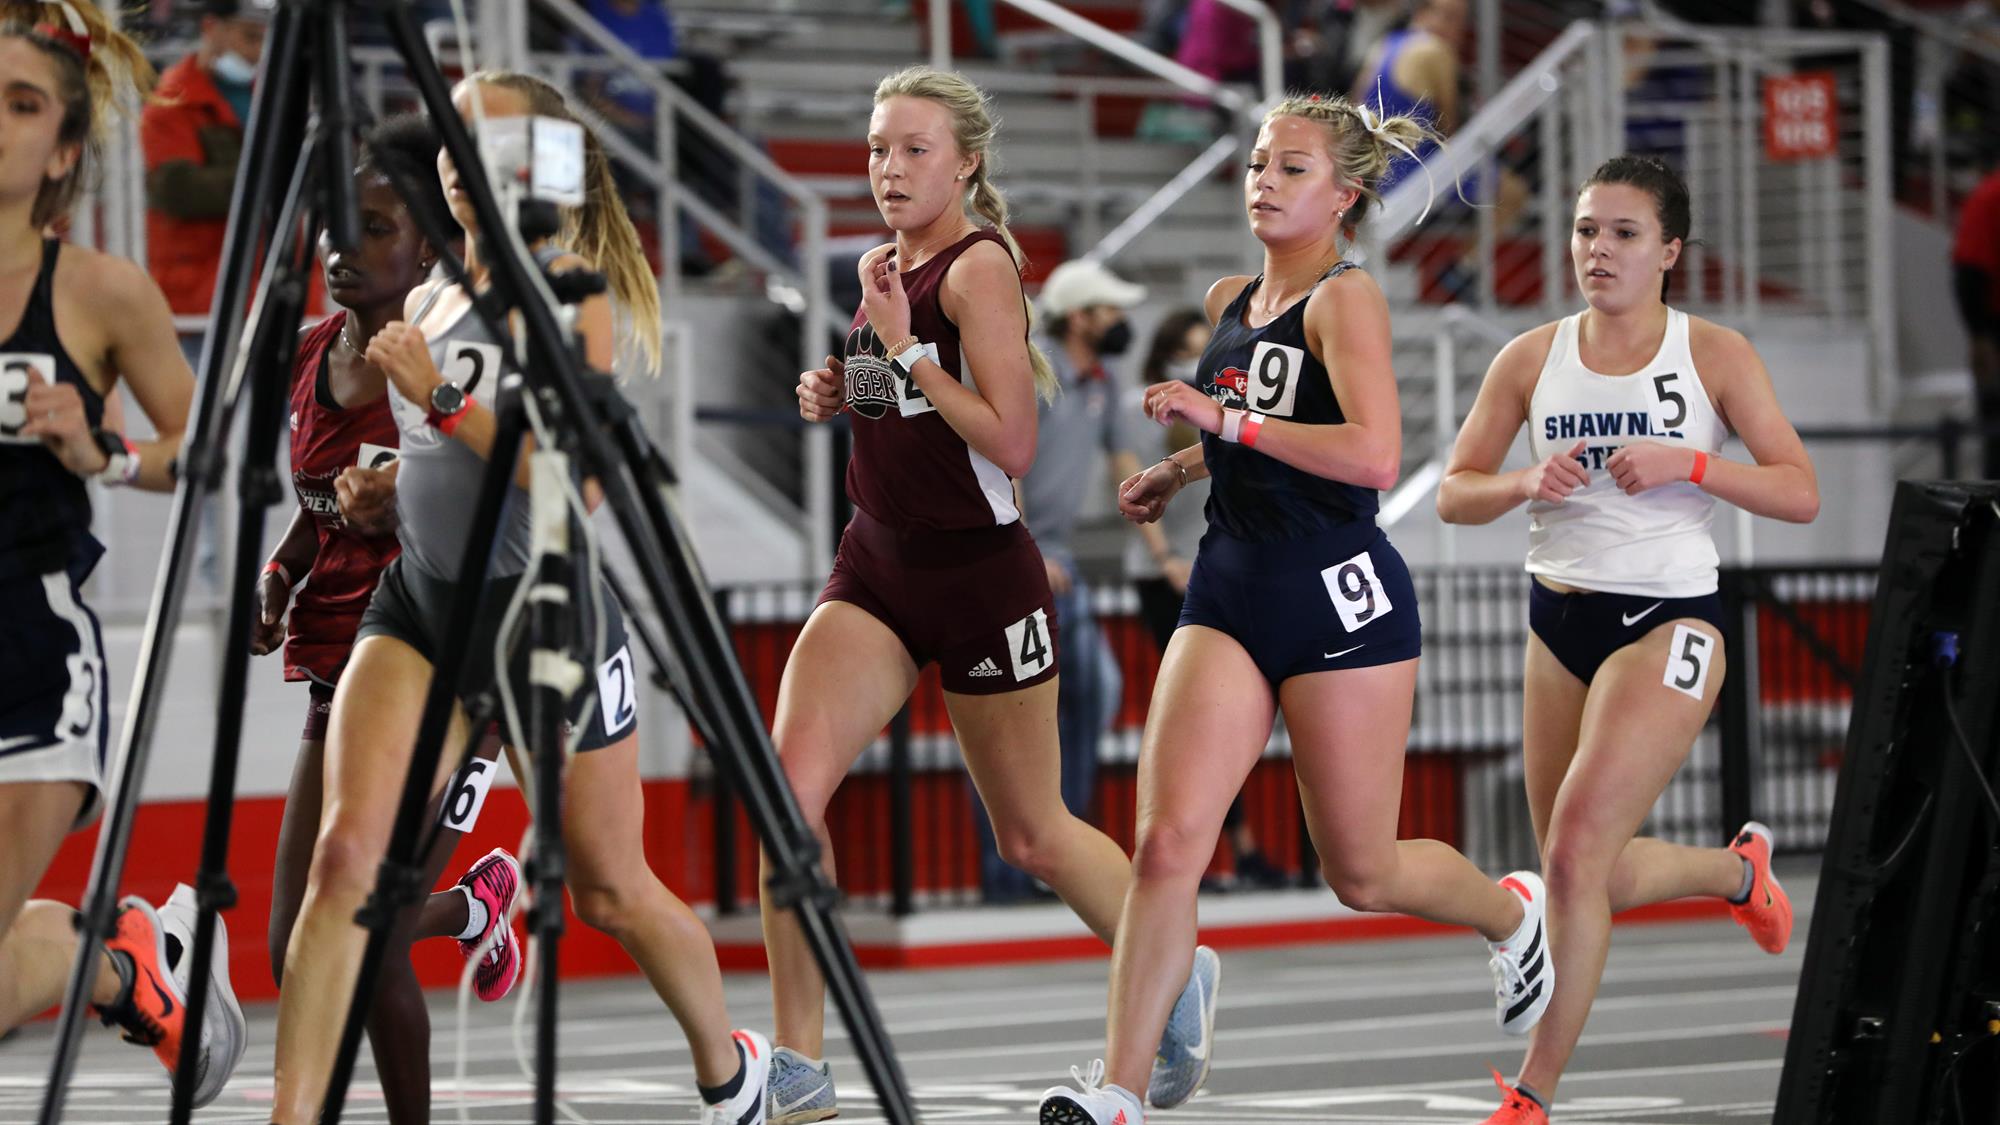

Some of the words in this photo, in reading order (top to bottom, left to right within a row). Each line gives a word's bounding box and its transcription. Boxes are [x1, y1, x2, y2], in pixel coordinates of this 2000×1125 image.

[845, 367, 900, 402] IGER
[1256, 347, 1289, 410] 9
[1653, 373, 1687, 428] 5
[1545, 412, 1684, 440] SHAWN
[1338, 563, 1375, 623] 9
[1020, 615, 1047, 669] 4
[1674, 633, 1706, 689] 5
[69, 661, 94, 737] 3
[608, 658, 632, 725] 2
[968, 668, 1003, 677] adidas
[450, 762, 487, 826] 6
